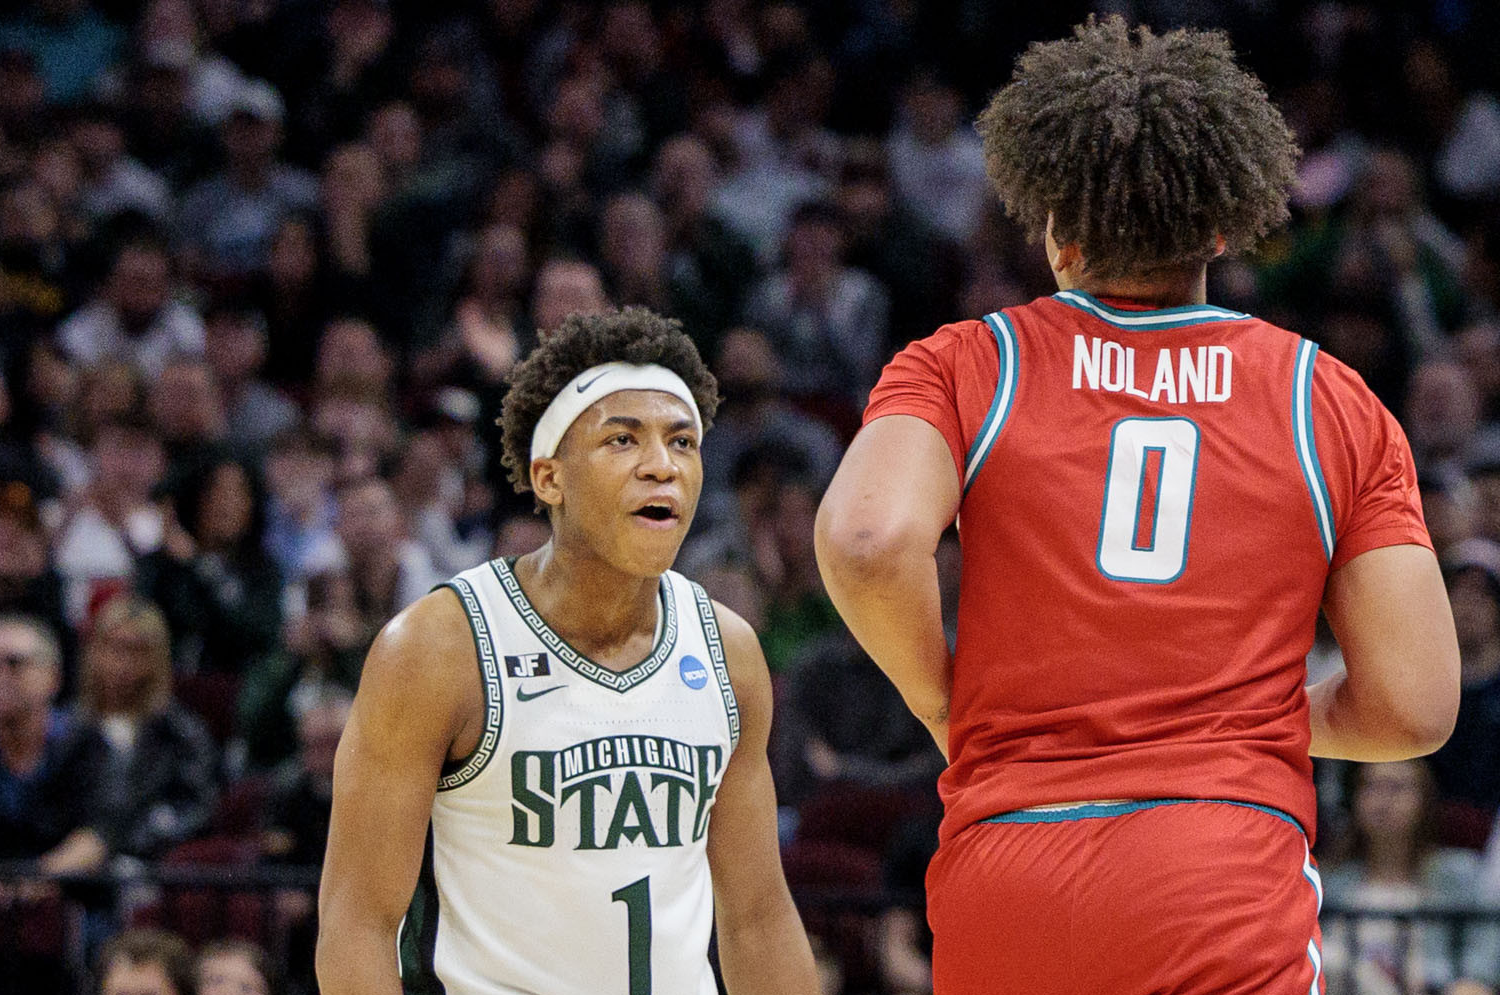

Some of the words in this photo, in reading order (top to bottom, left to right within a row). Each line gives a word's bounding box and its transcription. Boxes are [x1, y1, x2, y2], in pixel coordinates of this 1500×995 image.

[1072, 334, 1233, 404] NOLAND
[1096, 416, 1201, 585] 0
[514, 653, 540, 677] JF
[564, 738, 692, 778] MICHIGAN
[506, 745, 723, 851] STATE
